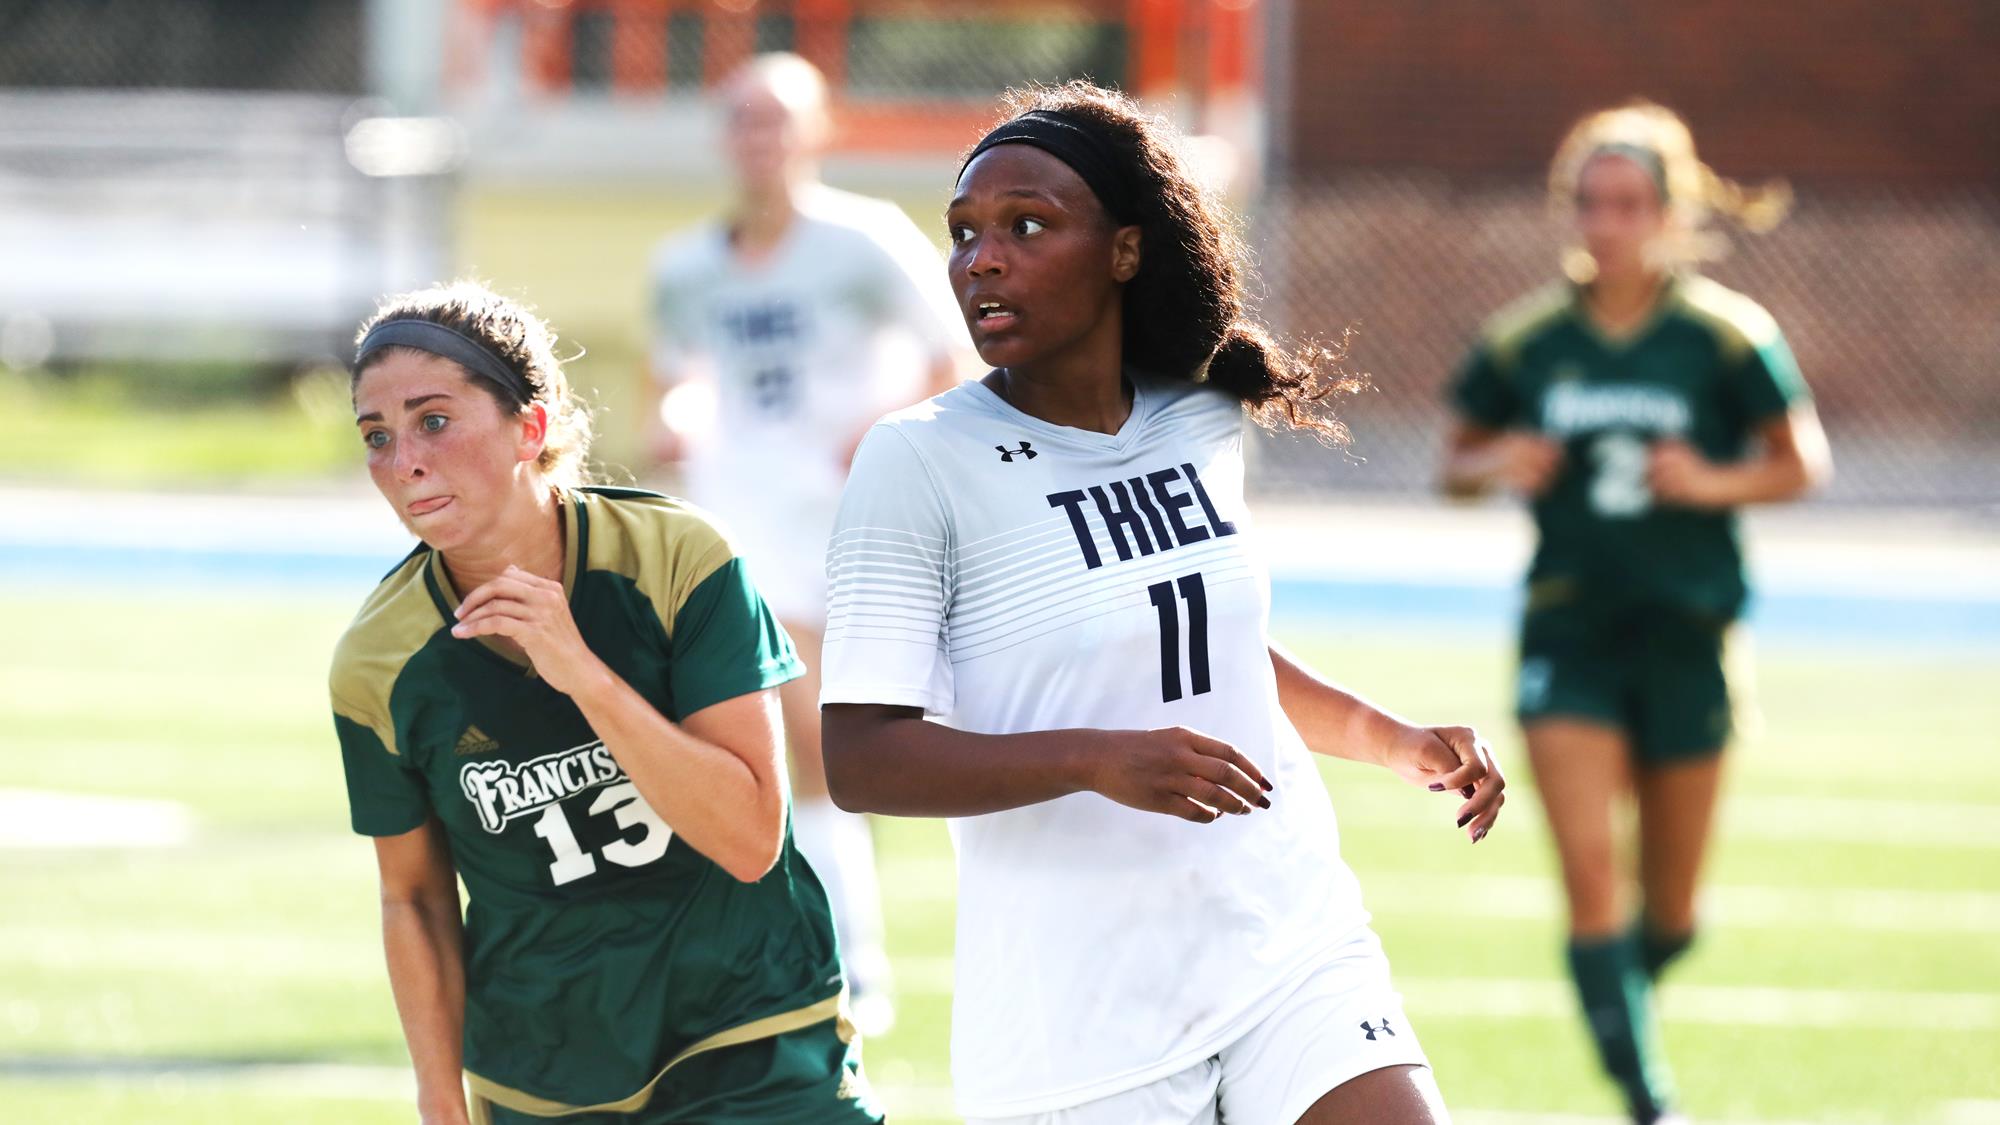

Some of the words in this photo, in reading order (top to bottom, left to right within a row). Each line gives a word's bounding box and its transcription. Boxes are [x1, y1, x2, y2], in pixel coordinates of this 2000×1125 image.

[1046, 462, 1239, 570] THIEL
[1147, 572, 1211, 703] 11
[533, 782, 673, 887] 13
